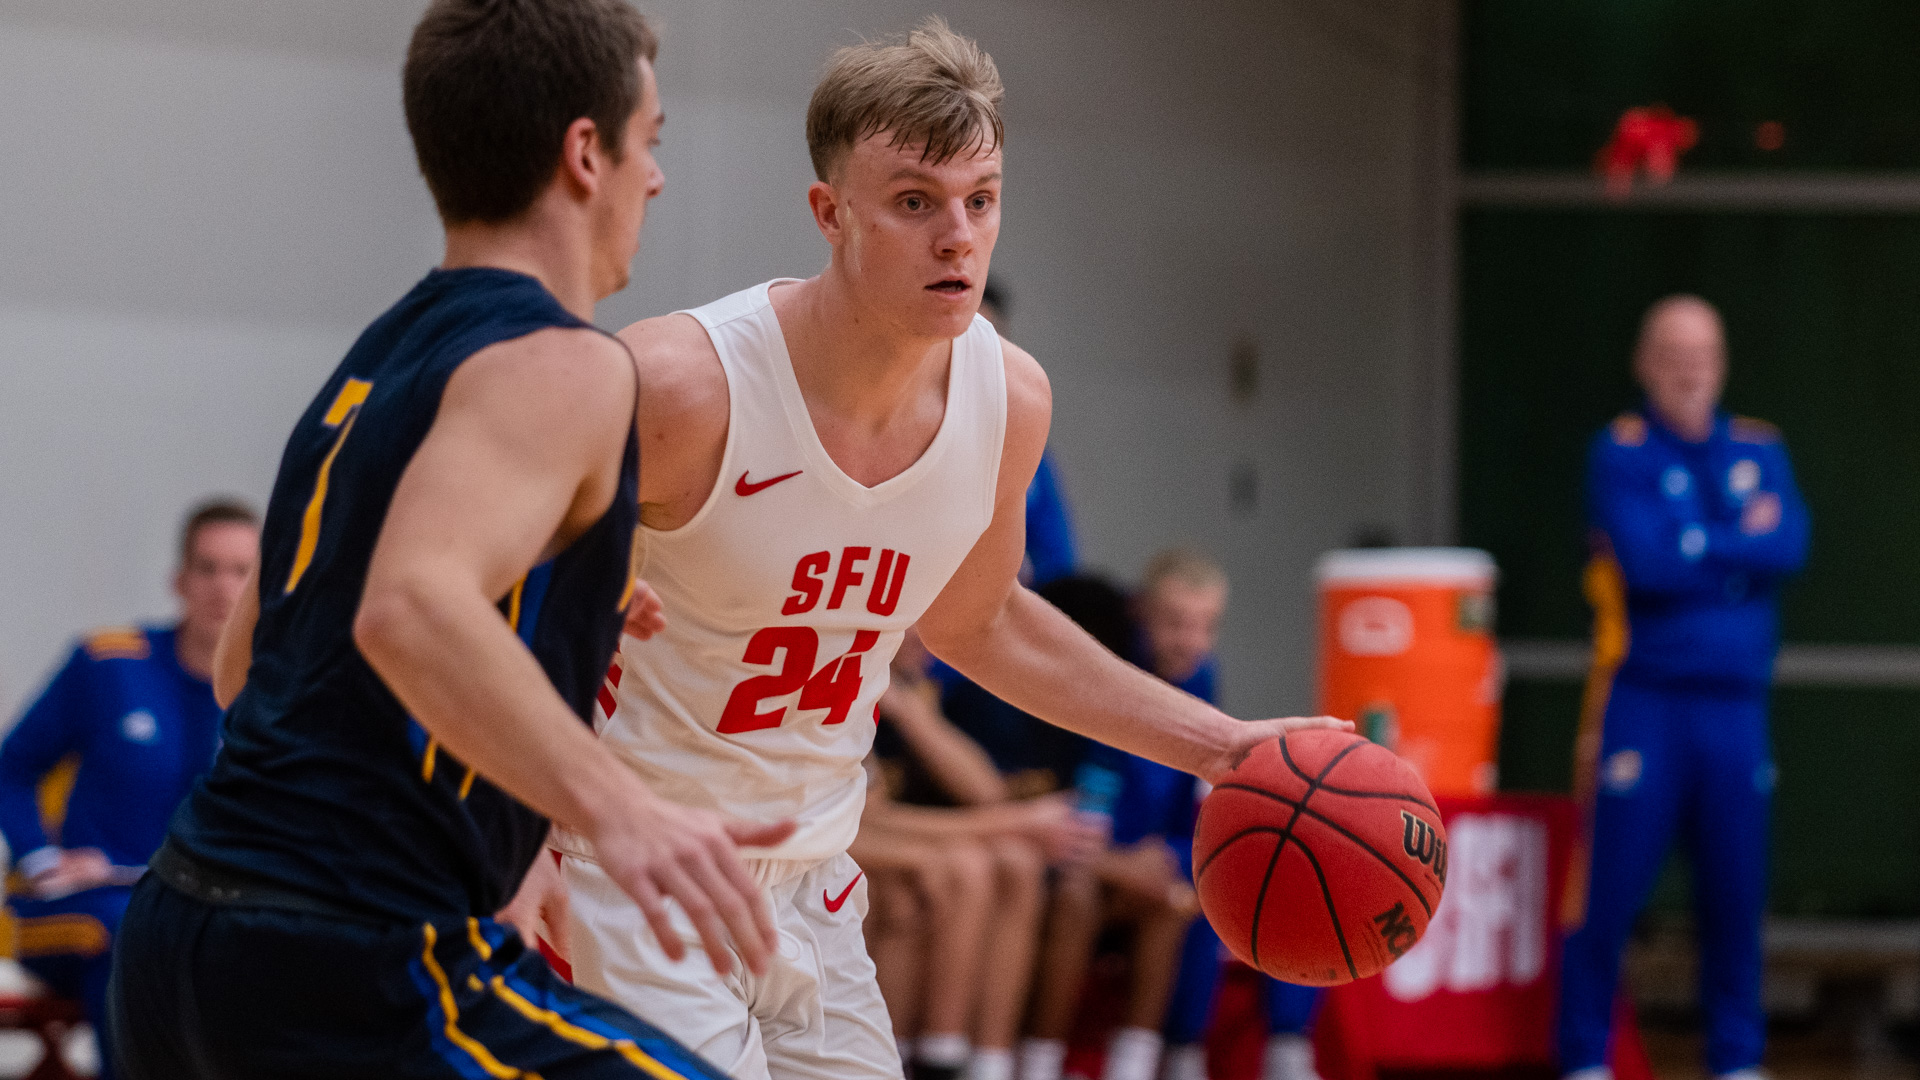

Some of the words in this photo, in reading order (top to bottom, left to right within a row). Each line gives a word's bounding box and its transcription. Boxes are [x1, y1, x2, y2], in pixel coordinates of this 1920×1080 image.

[284, 377, 374, 594] 7
[781, 546, 911, 617] SFU
[716, 626, 881, 734] 24
